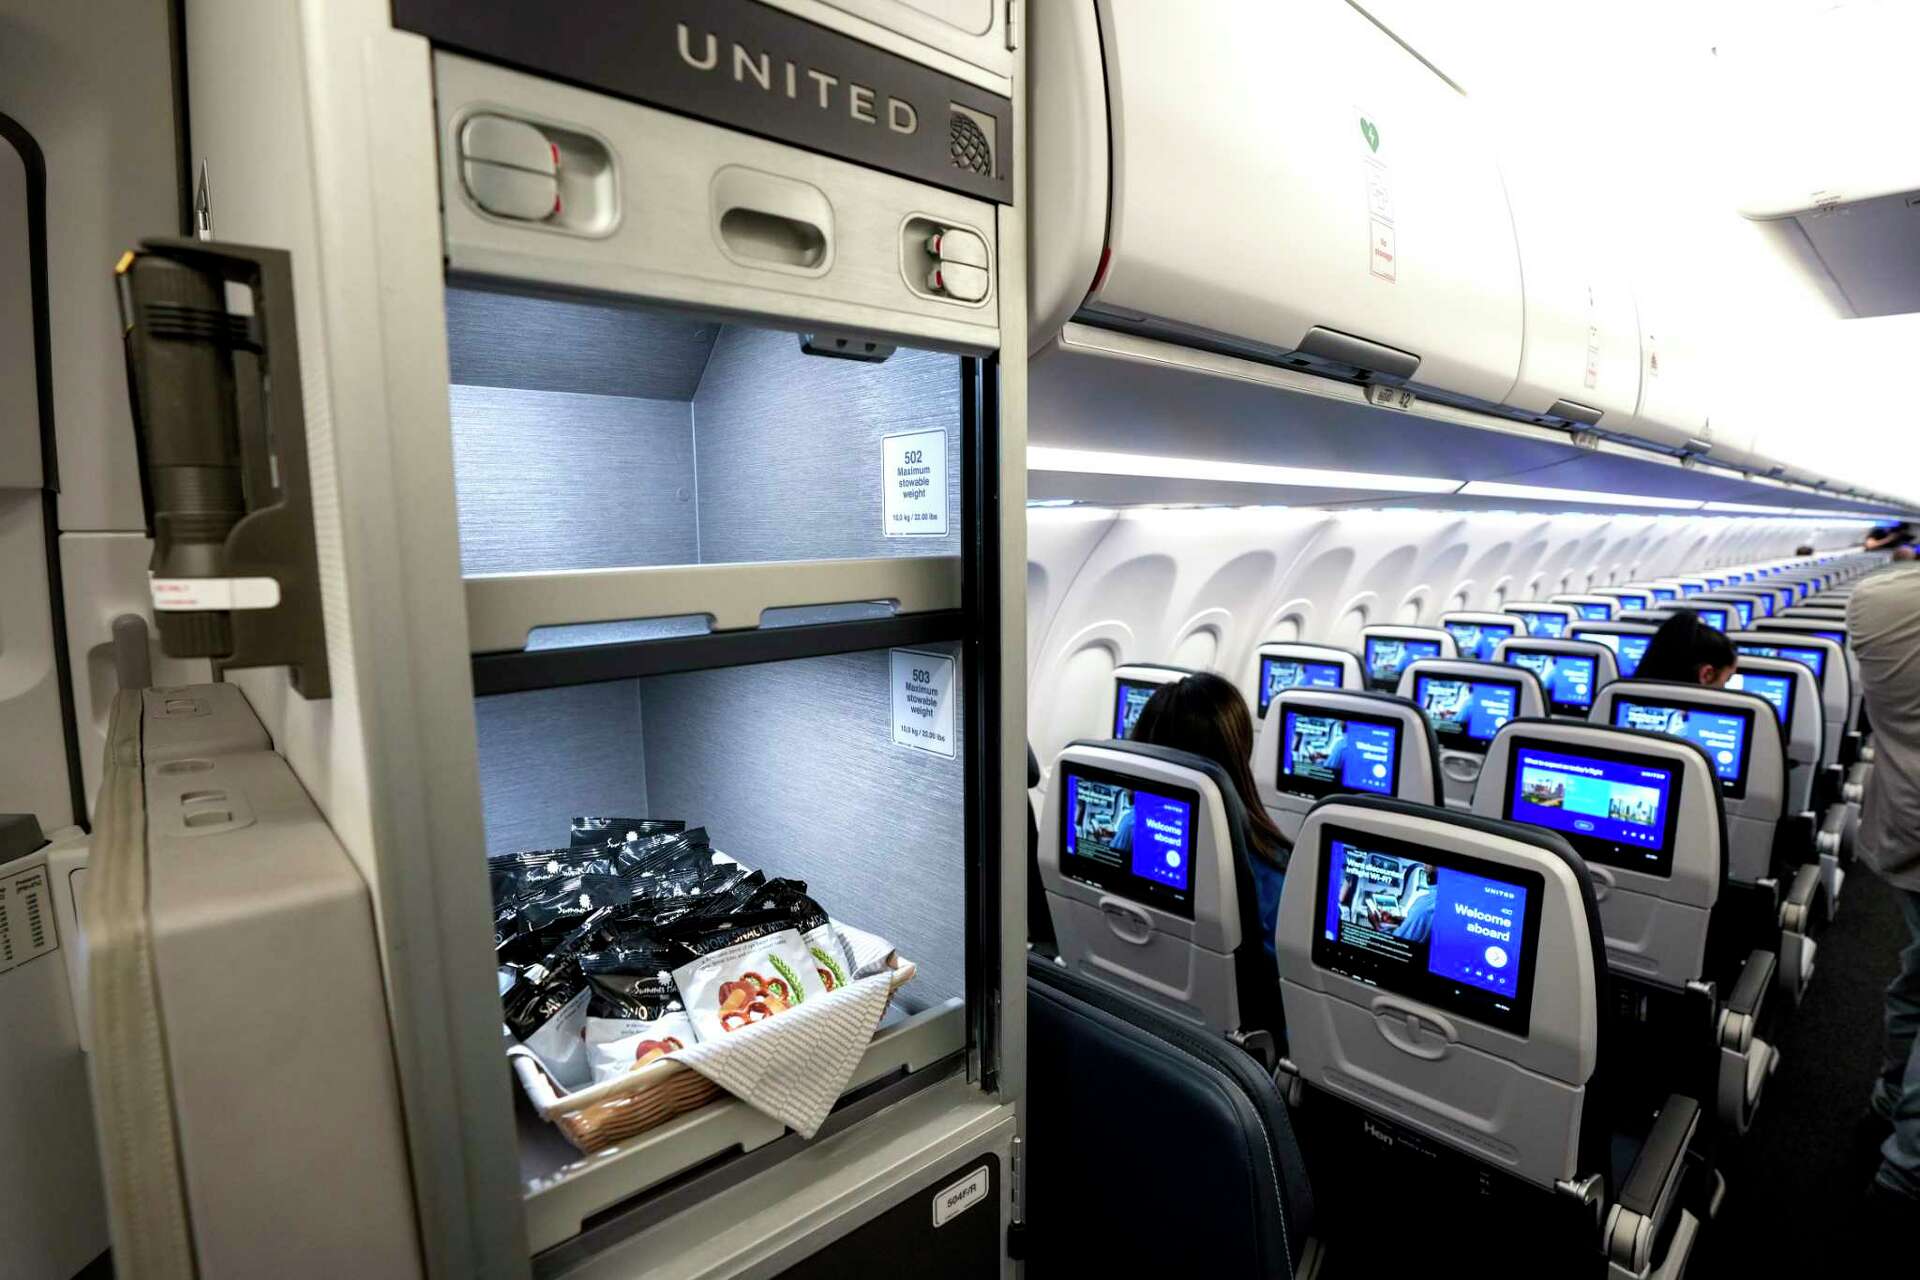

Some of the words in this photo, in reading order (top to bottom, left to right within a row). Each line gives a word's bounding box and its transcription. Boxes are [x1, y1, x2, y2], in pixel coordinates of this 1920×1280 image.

[676, 23, 919, 135] UNITED
[904, 450, 922, 464] 502
[897, 465, 931, 476] Maximum
[899, 477, 930, 488] stowable
[903, 488, 926, 500] weight
[912, 669, 930, 684] 503
[905, 682, 938, 696] Maximum
[906, 694, 938, 707] stowable
[911, 705, 933, 717] weight
[1146, 817, 1182, 836] Welcome
[1154, 832, 1182, 847] aboard
[1484, 886, 1515, 899] UNITED
[1454, 902, 1512, 928] Welcome
[1466, 922, 1510, 942] aboard
[634, 979, 665, 995] Summer
